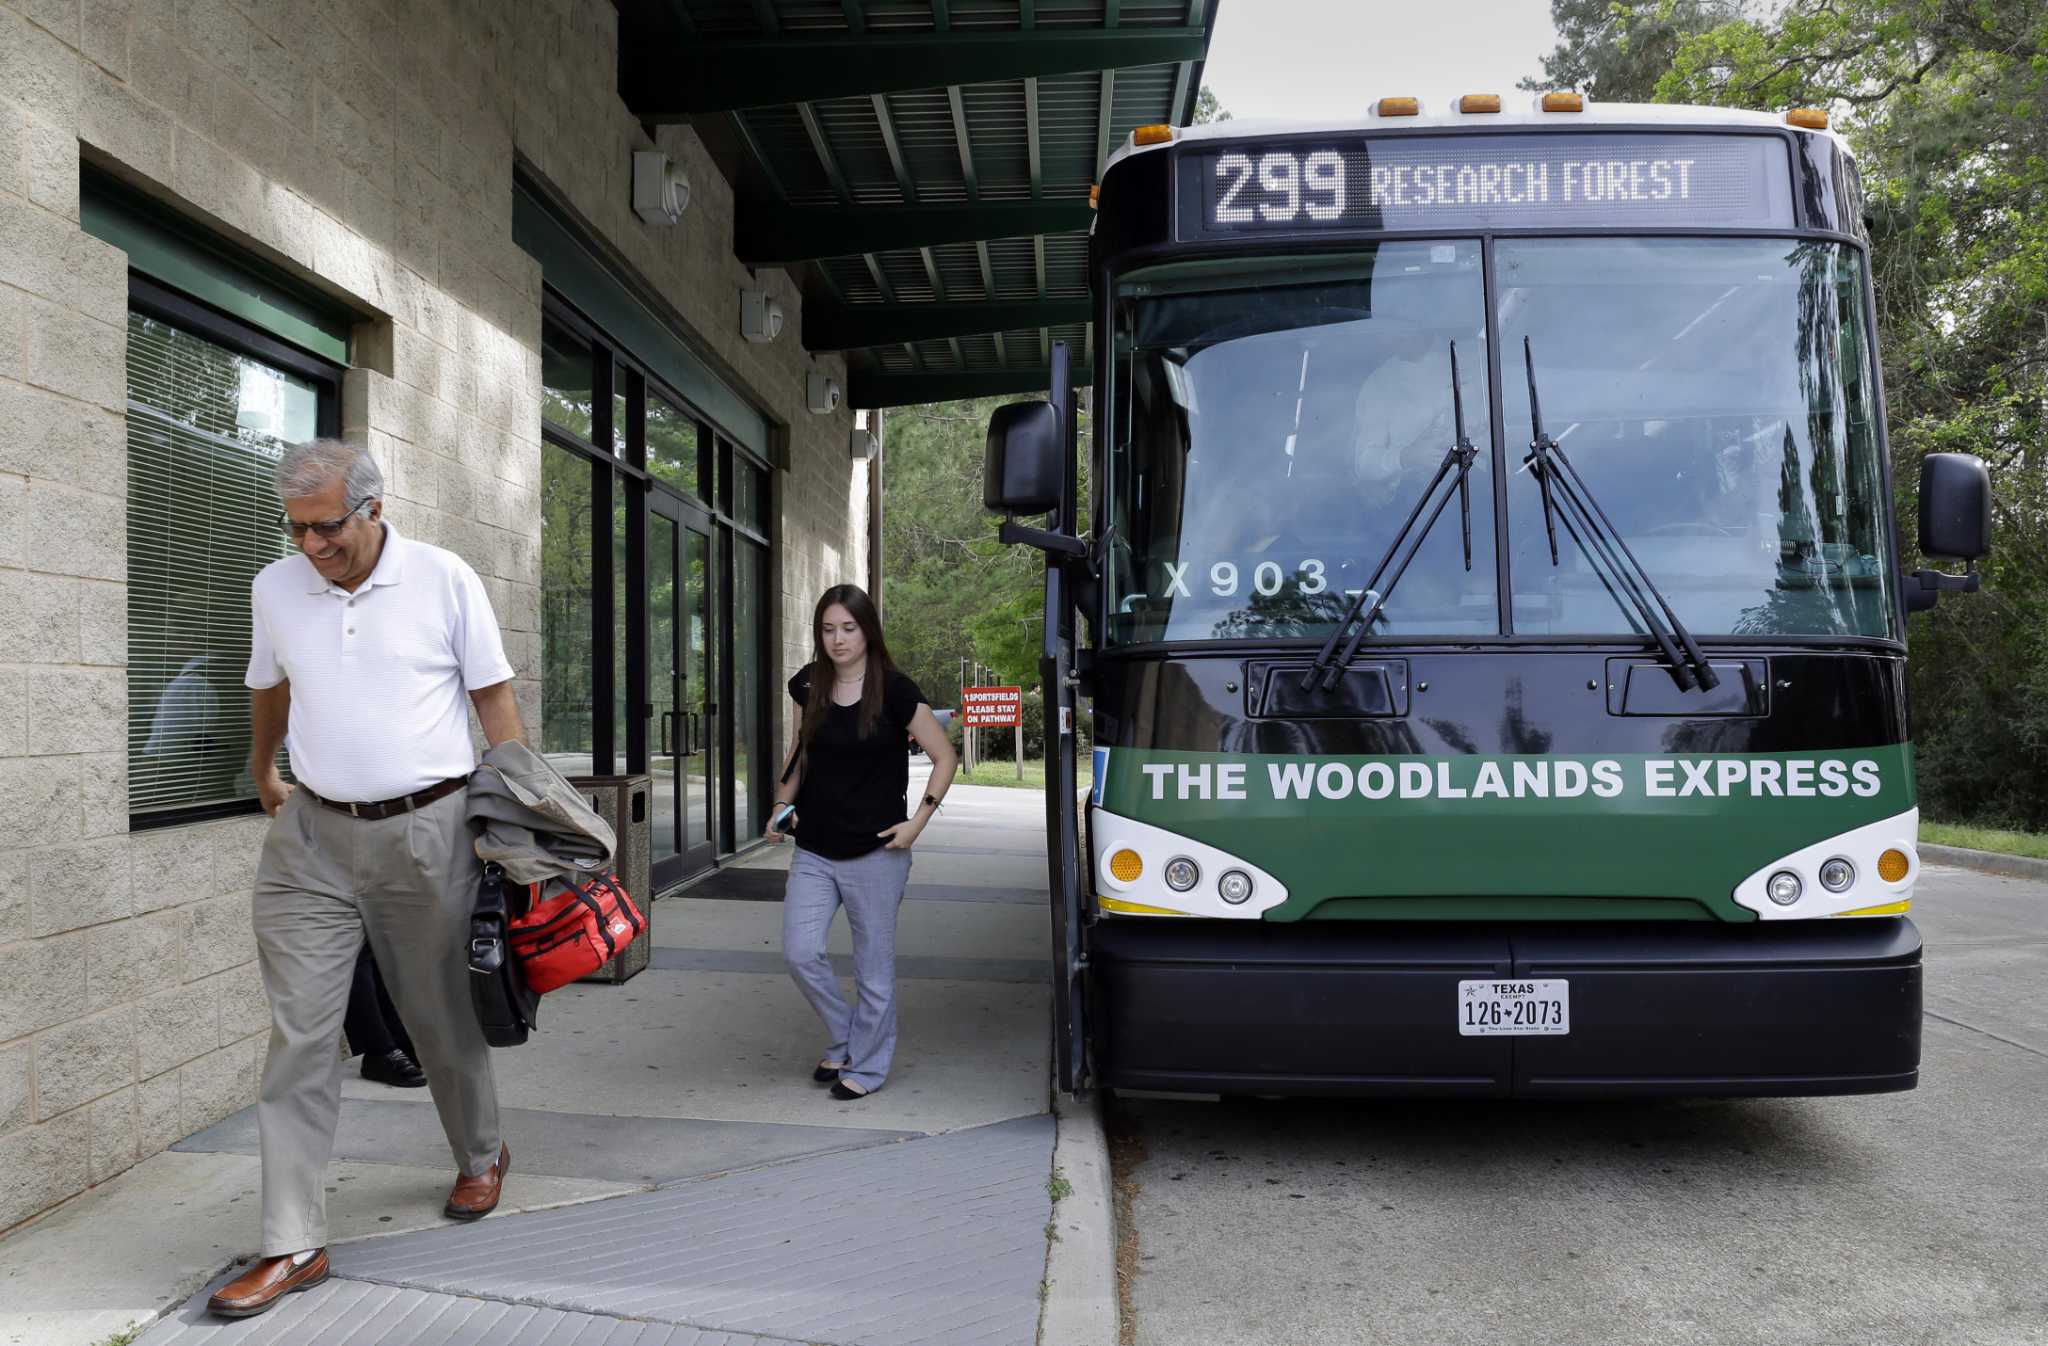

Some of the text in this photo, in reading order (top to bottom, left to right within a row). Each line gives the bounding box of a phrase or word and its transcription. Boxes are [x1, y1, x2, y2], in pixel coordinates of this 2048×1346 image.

[1215, 151, 1695, 223] 299 RESEARCH FOREST
[967, 704, 1016, 714] PLEASE STAY
[968, 714, 1016, 723] ON PATHWAY
[1142, 759, 1881, 799] THE WOODLANDS EXPRESS
[1492, 984, 1534, 994] TEXAS
[1465, 1000, 1562, 1025] 126 2073
